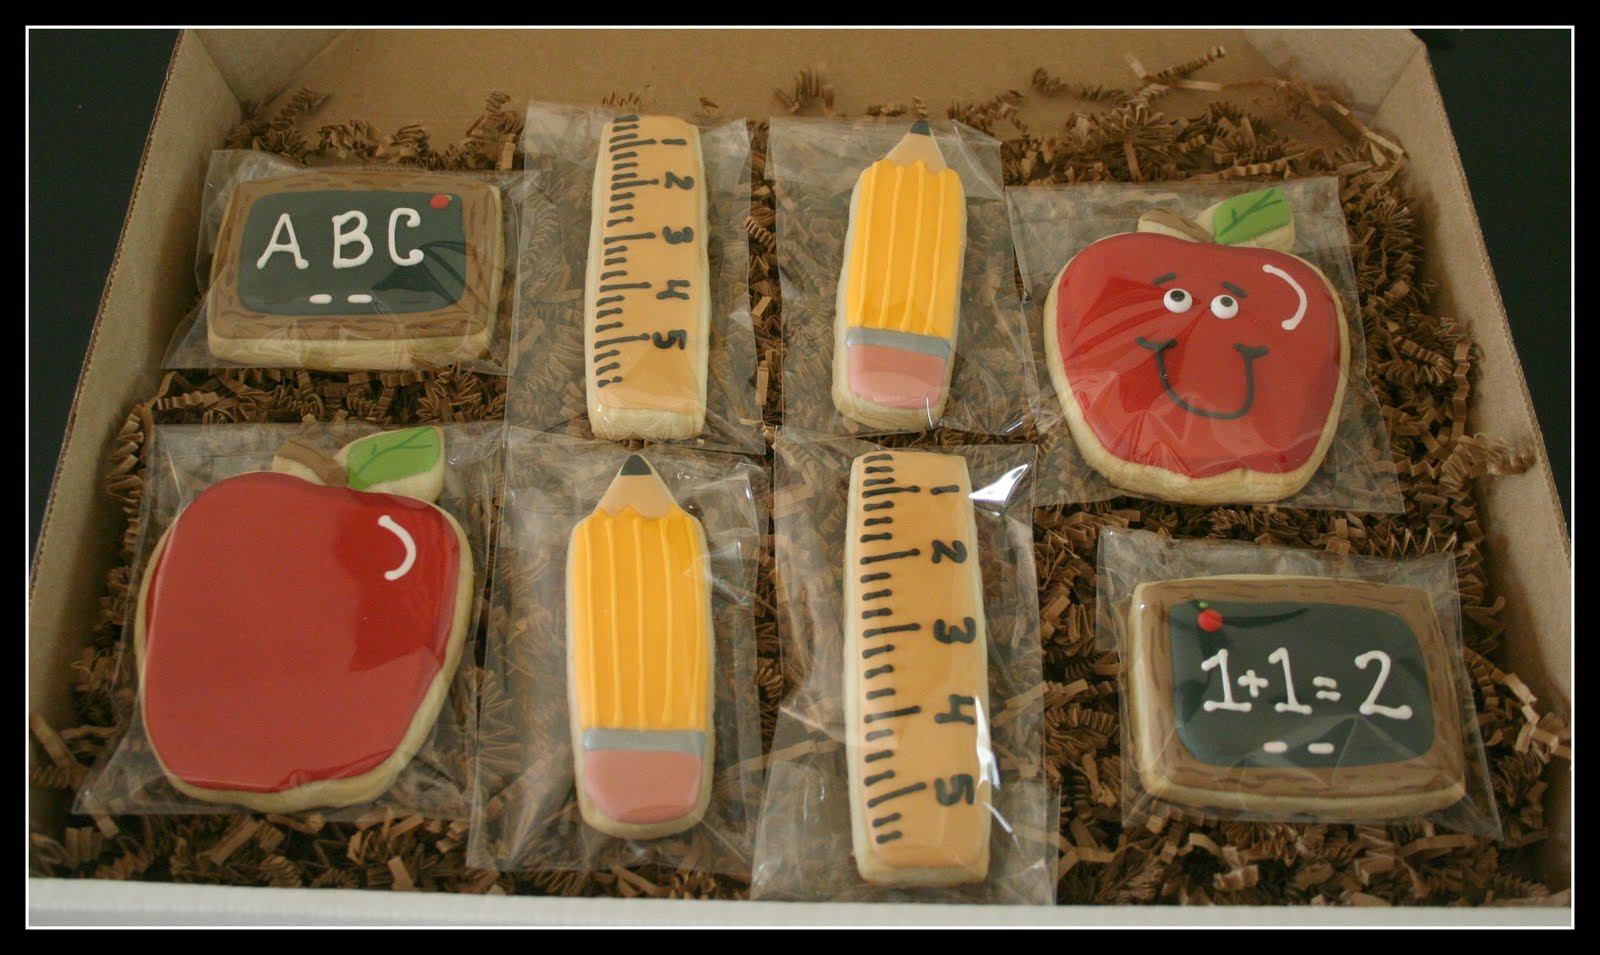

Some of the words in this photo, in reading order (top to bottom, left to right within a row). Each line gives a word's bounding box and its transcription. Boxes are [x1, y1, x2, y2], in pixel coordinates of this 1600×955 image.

[661, 138, 687, 146] 1
[664, 171, 694, 190] 2
[662, 226, 694, 245] 3
[656, 279, 690, 300] 4
[652, 329, 687, 350] 5
[930, 485, 960, 496] 1
[931, 539, 968, 564] 2
[933, 616, 977, 645] 3
[935, 694, 976, 726] 4
[934, 773, 975, 807] 5
